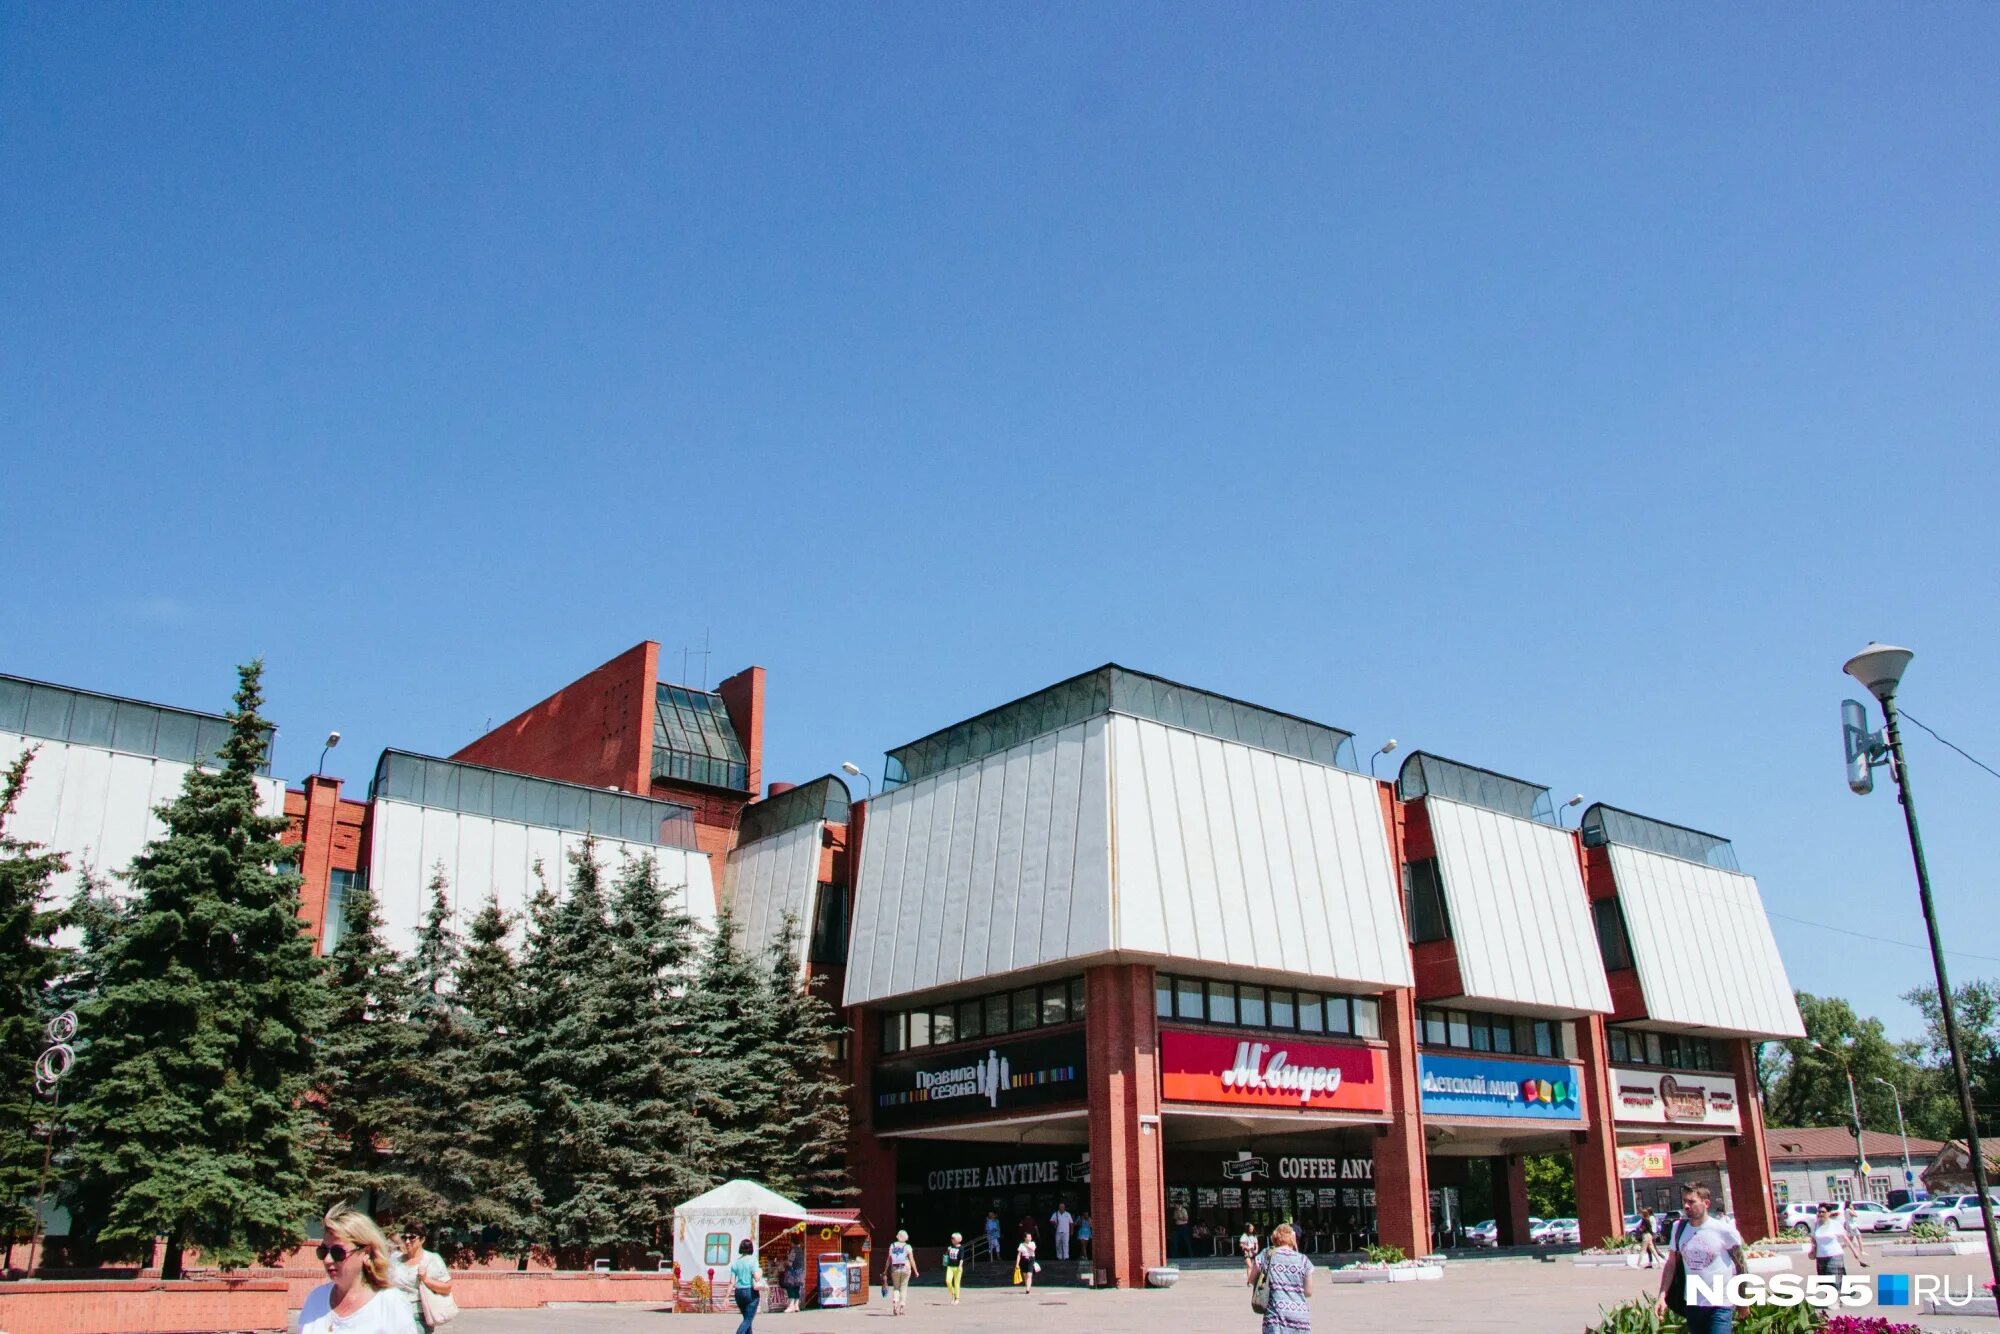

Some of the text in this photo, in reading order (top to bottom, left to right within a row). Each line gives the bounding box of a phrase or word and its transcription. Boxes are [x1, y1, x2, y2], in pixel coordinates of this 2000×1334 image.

[916, 1066, 976, 1088] Правила
[1423, 1071, 1519, 1101] Детский мир
[931, 1081, 977, 1100] сезона
[928, 1160, 1059, 1191] COFFEE ANYTIME
[1279, 1157, 1337, 1179] COFFEE
